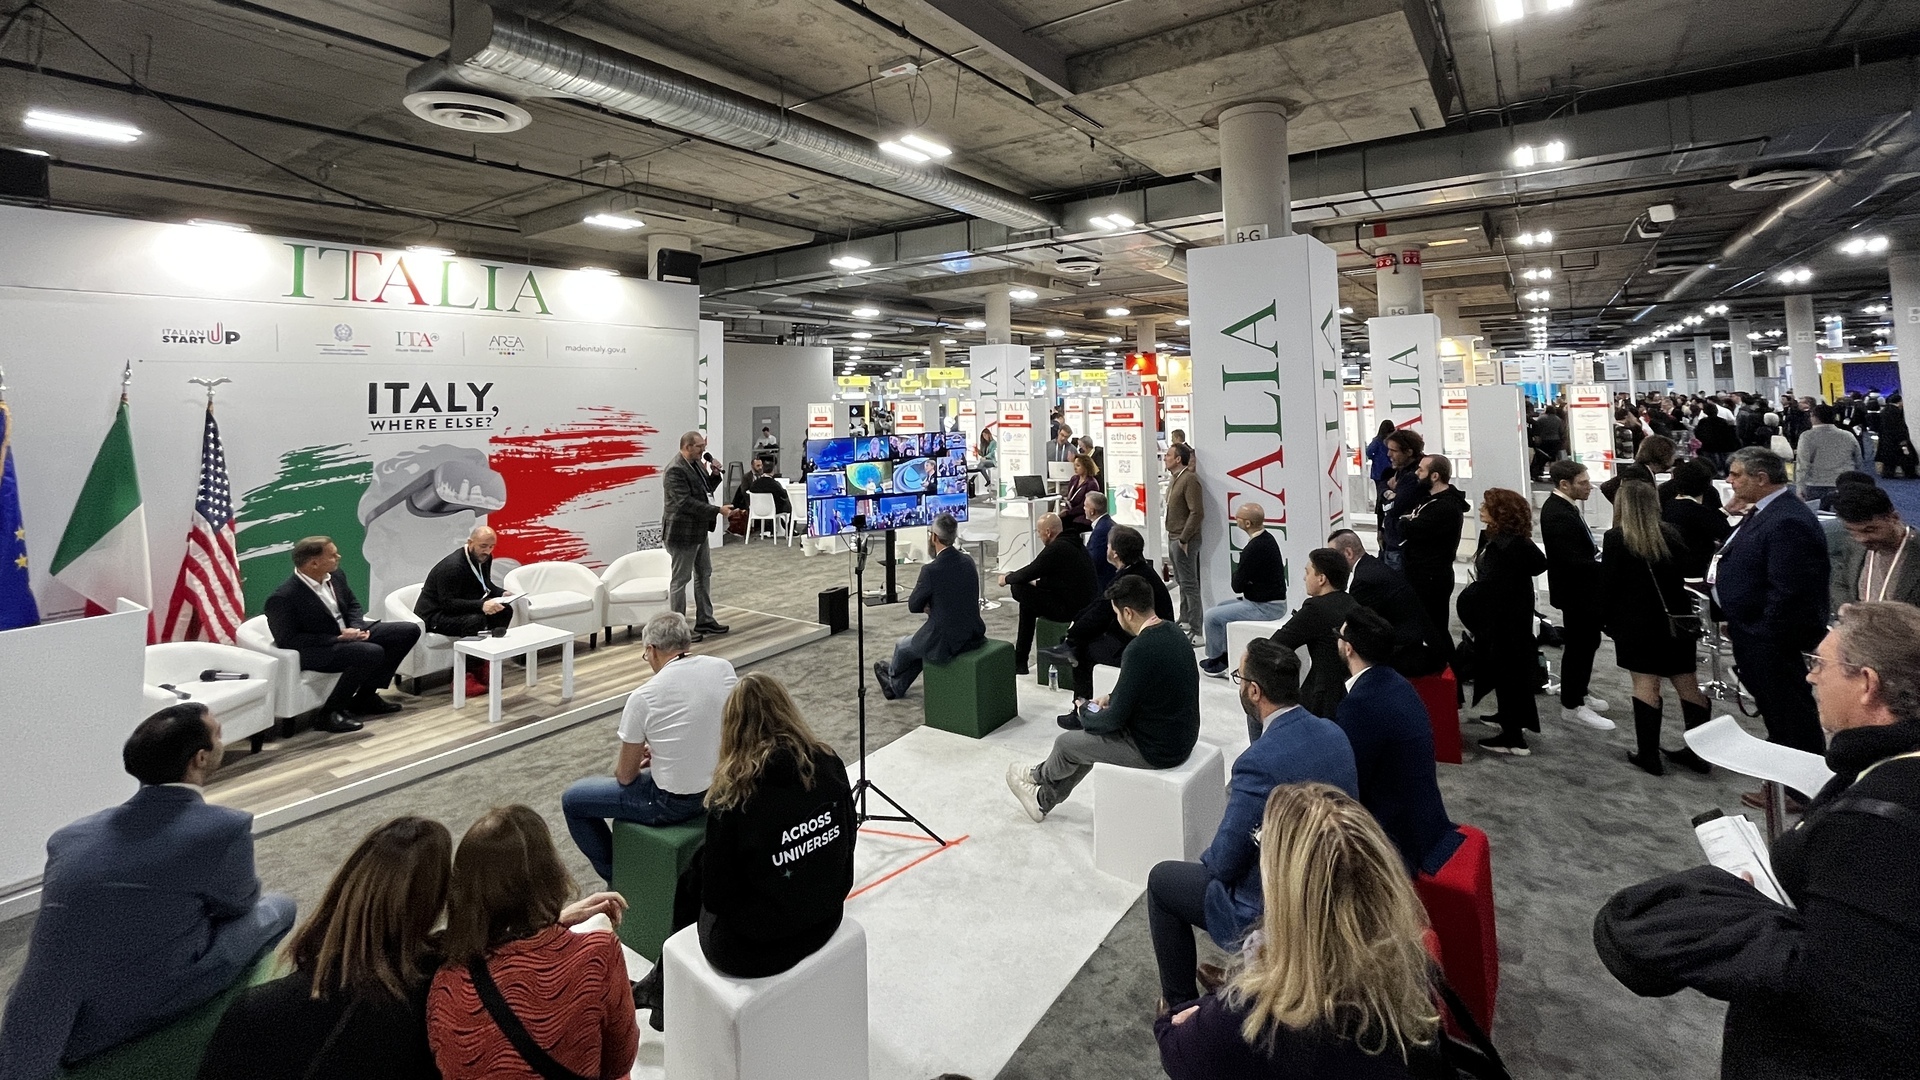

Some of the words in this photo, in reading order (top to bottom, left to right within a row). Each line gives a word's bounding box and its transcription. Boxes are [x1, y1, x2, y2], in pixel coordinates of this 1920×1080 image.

[1236, 229, 1261, 243] B-G
[282, 243, 553, 315] ITALIA
[162, 328, 205, 336] ITALIAN
[395, 330, 434, 348] ITA
[488, 335, 525, 348] AREA
[565, 344, 627, 354] madeinitaly.gov.it
[368, 382, 499, 417] ITALY,
[1442, 389, 1466, 397] ITALI
[999, 402, 1030, 411] ITALIA
[1105, 399, 1141, 409] ITALIA
[1320, 303, 1344, 530] TALIA
[371, 418, 437, 431] WHERE
[445, 417, 492, 428] ELSE?
[1111, 432, 1138, 441] athics
[1220, 299, 1290, 588] TALIA
[781, 811, 832, 845] ACROSS
[771, 825, 840, 867] UNIVERSES
